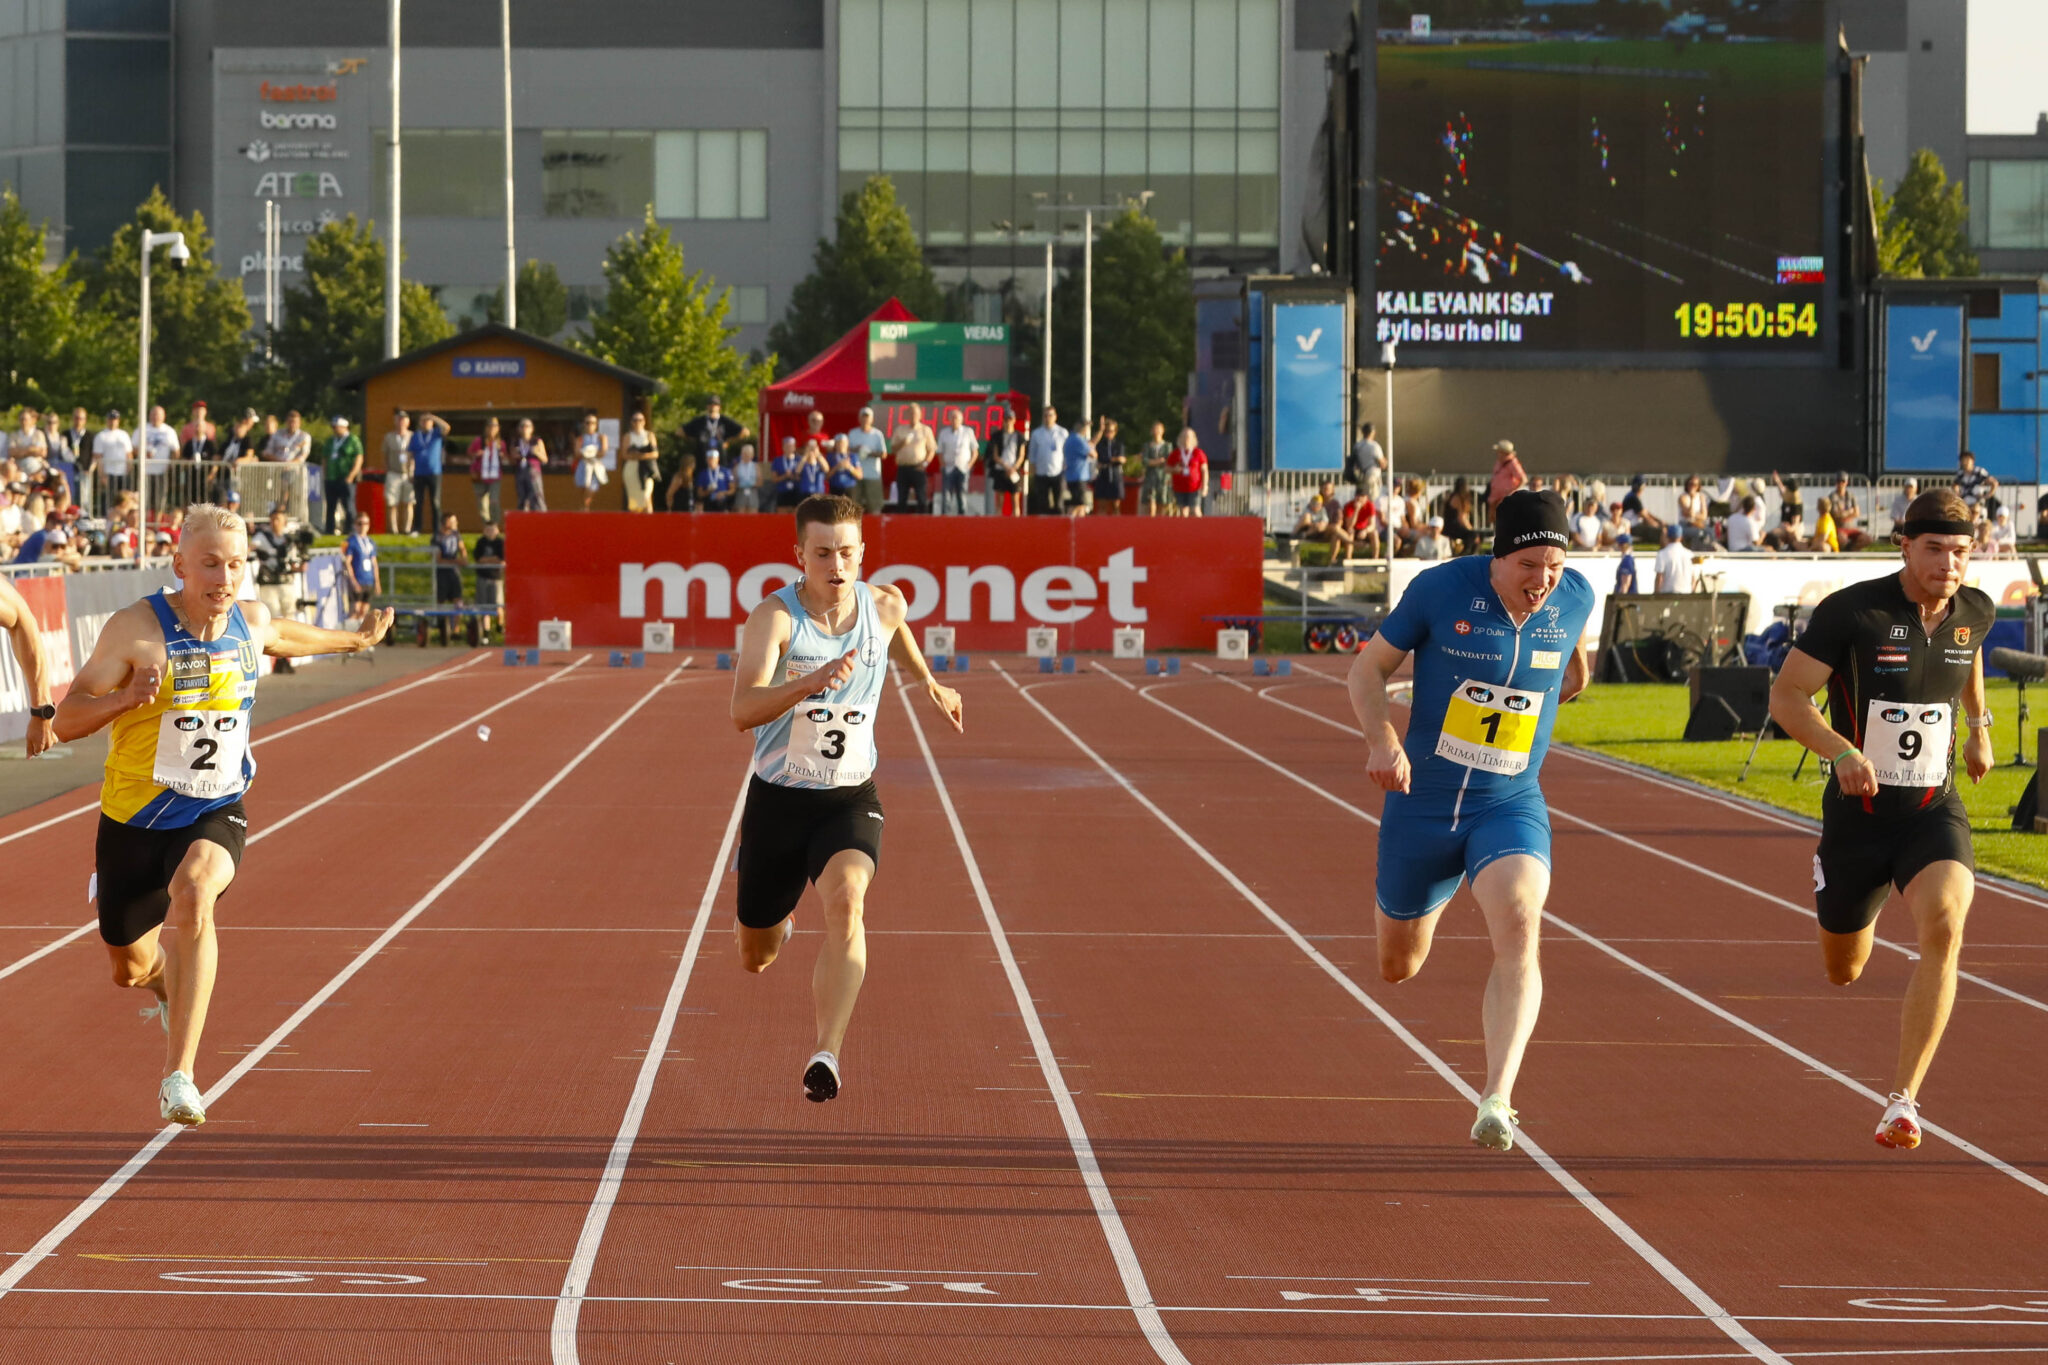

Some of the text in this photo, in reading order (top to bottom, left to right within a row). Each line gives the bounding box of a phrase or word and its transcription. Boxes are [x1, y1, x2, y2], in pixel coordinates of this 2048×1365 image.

[260, 110, 337, 129] barona
[1376, 291, 1554, 315] KALEVANKISAT
[1674, 302, 1818, 338] 19:50:54
[880, 324, 908, 339] KOTI
[963, 325, 1004, 340] VIERAS
[1376, 318, 1523, 346] #yleisurheilu
[475, 362, 520, 374] KAHVIO
[618, 546, 1147, 625] moonet
[1486, 627, 1505, 637] Oulu
[1447, 647, 1503, 661] MANDATUM
[175, 659, 207, 671] SAVOX
[1480, 711, 1502, 744] 1
[189, 737, 218, 770] 2
[820, 729, 846, 760] 3
[1440, 739, 1523, 770] PRIMA TIMBER
[1897, 730, 1923, 760] 9
[786, 761, 825, 779] PRIMA
[1874, 768, 1900, 780] RIMA
